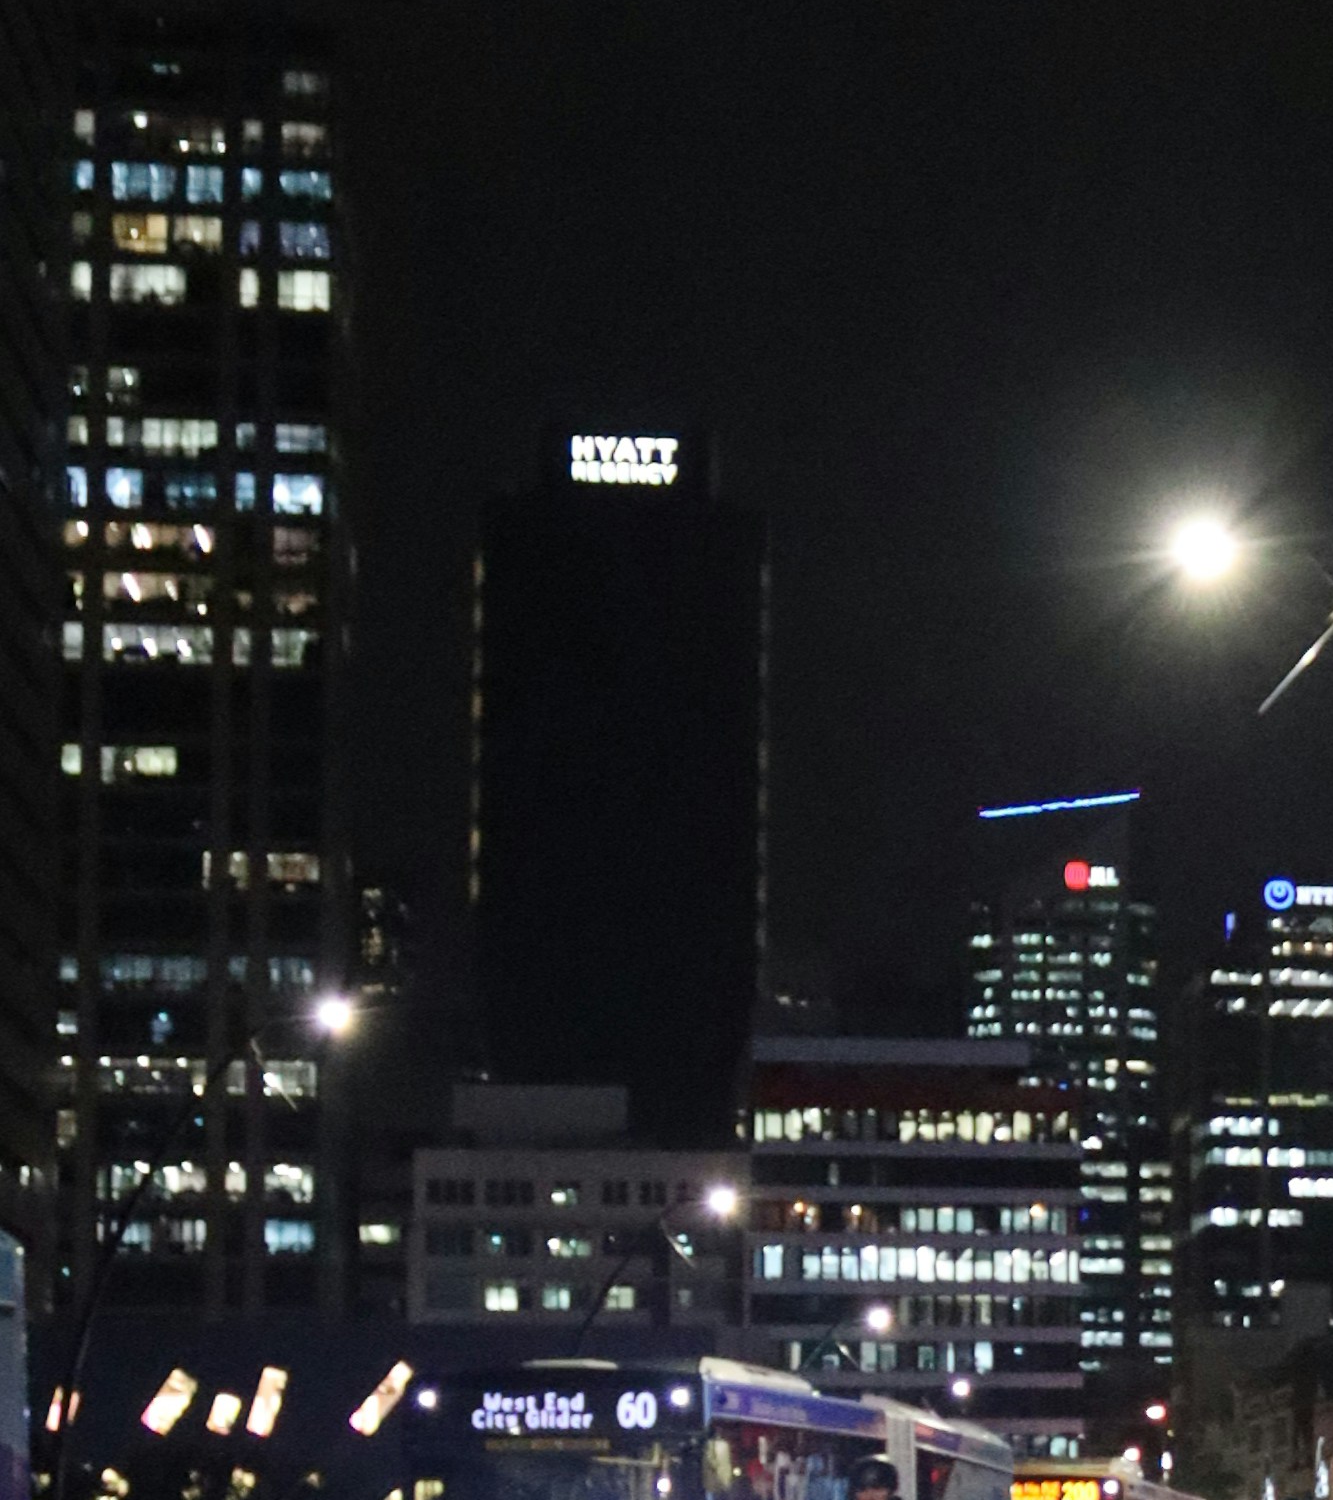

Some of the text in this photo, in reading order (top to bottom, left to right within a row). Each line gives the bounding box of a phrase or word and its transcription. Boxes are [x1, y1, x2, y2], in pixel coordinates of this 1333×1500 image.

[571, 435, 678, 464] HYATT
[483, 1391, 657, 1429] West End 60
[525, 1409, 593, 1430] Glider
